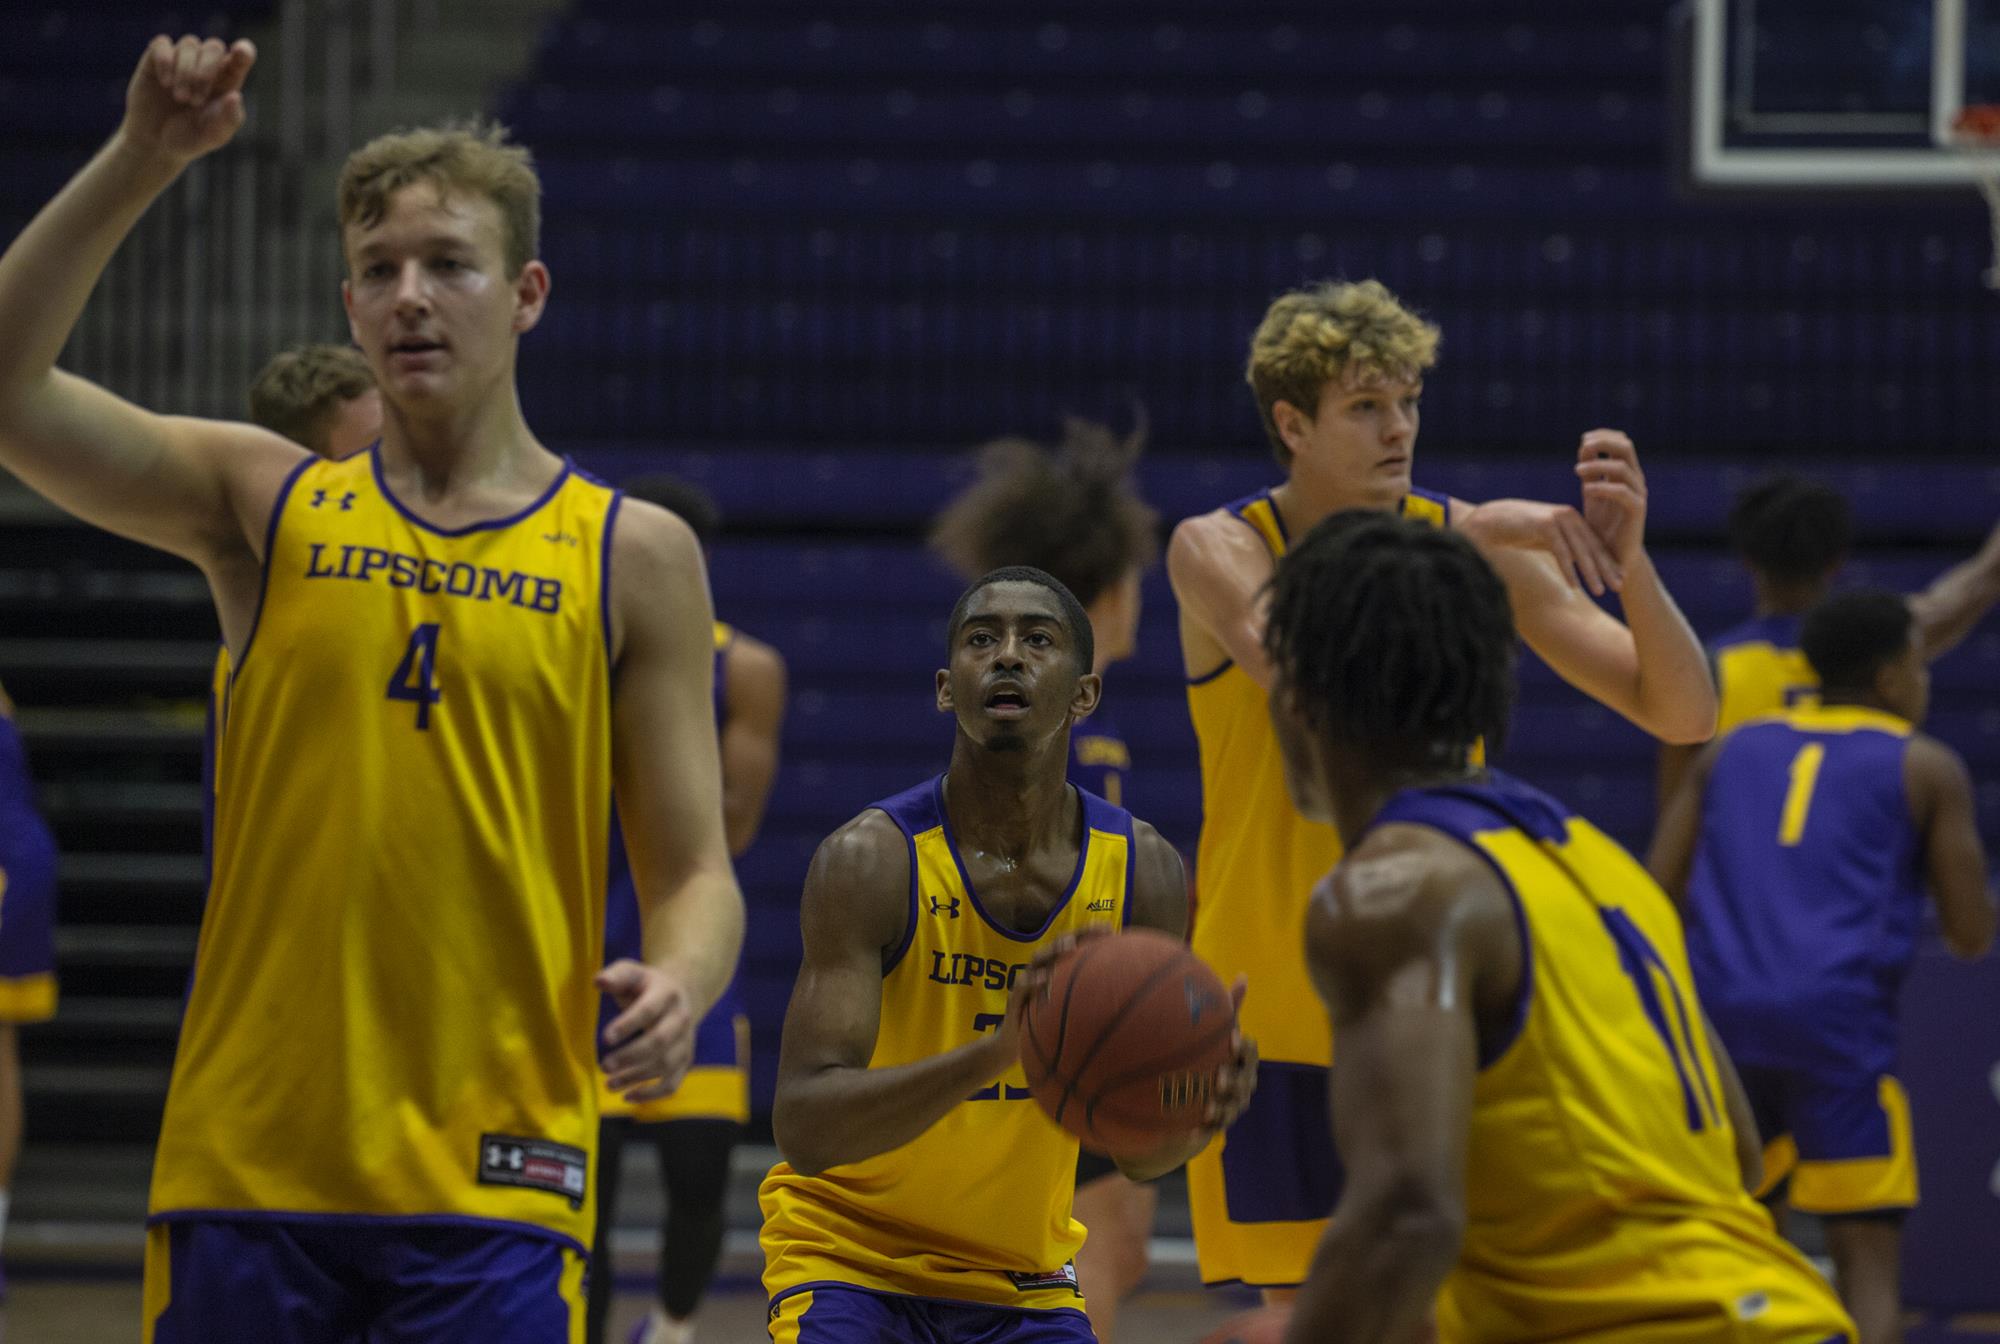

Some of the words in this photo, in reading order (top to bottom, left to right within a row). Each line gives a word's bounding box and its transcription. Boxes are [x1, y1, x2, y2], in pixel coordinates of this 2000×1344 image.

[305, 543, 562, 614] LIPSCOMB
[386, 622, 441, 730] 4
[1778, 742, 1825, 846] 1
